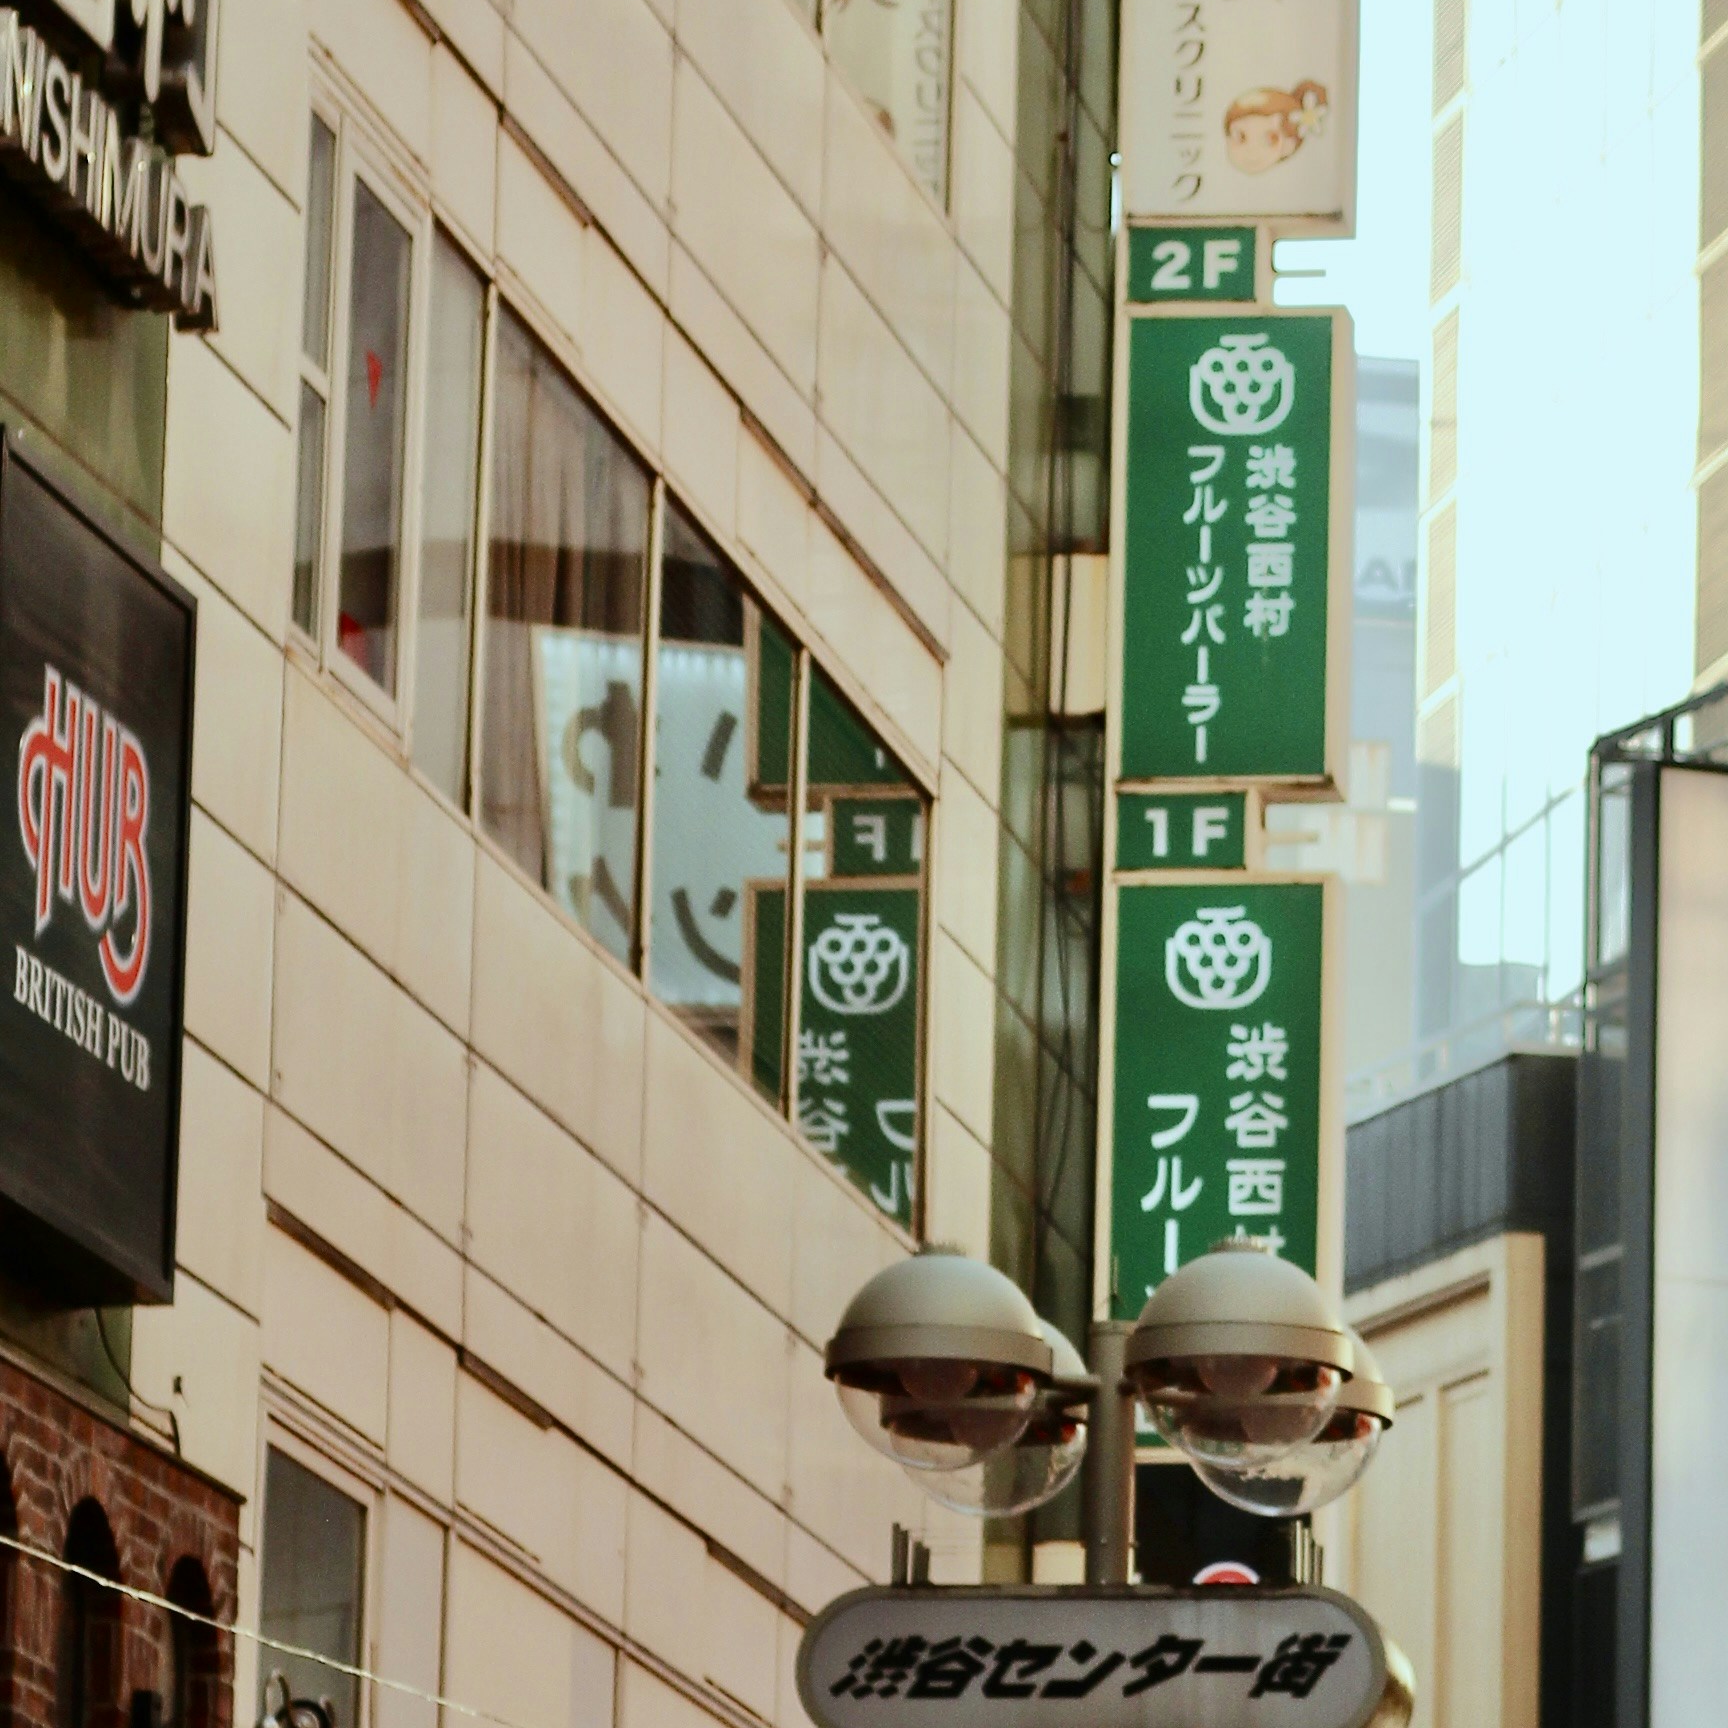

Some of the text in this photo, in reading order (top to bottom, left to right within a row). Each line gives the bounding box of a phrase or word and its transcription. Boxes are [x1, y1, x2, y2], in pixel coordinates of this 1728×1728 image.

[4, 9, 219, 332] NISHIMURA
[1150, 239, 1242, 290] 2F
[1243, 444, 1297, 637] 渋谷西村
[18, 664, 151, 1007] HUB
[1145, 807, 1230, 858] 1F
[15, 946, 151, 1091] BRITISH PUB
[1140, 1093, 1203, 1282] フルー
[830, 1633, 1352, 1700] 渋谷センター街
